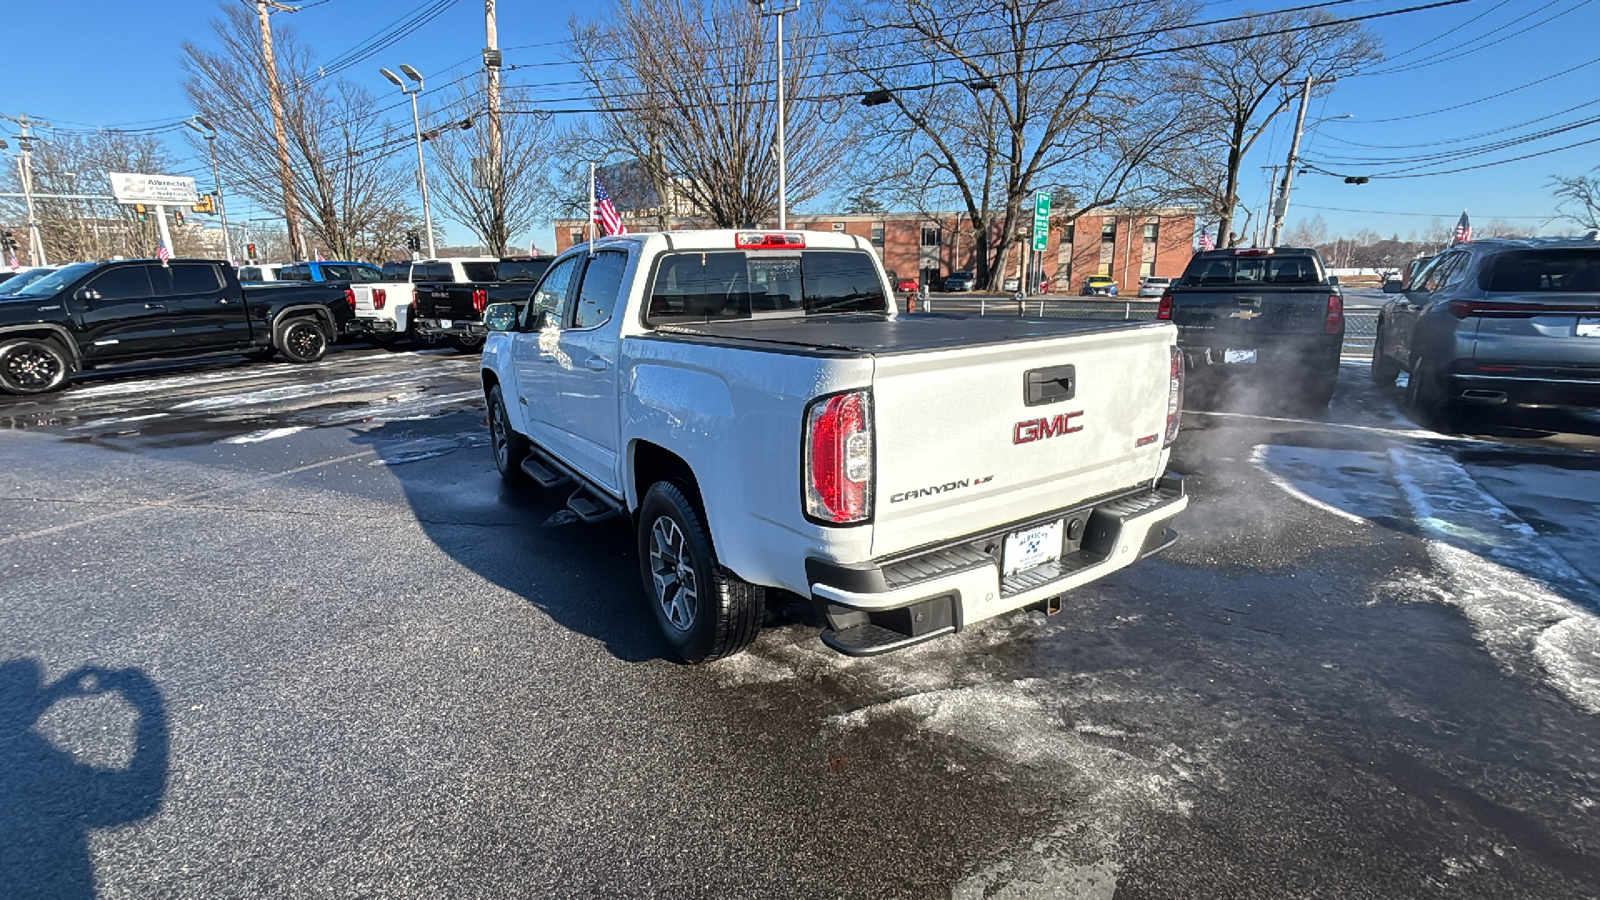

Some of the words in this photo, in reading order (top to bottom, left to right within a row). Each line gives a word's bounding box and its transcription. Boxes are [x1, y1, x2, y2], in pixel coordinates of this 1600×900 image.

[1013, 410, 1085, 445] GMC
[890, 478, 970, 503] CANYON
[1019, 532, 1048, 546] ALBRECHT
